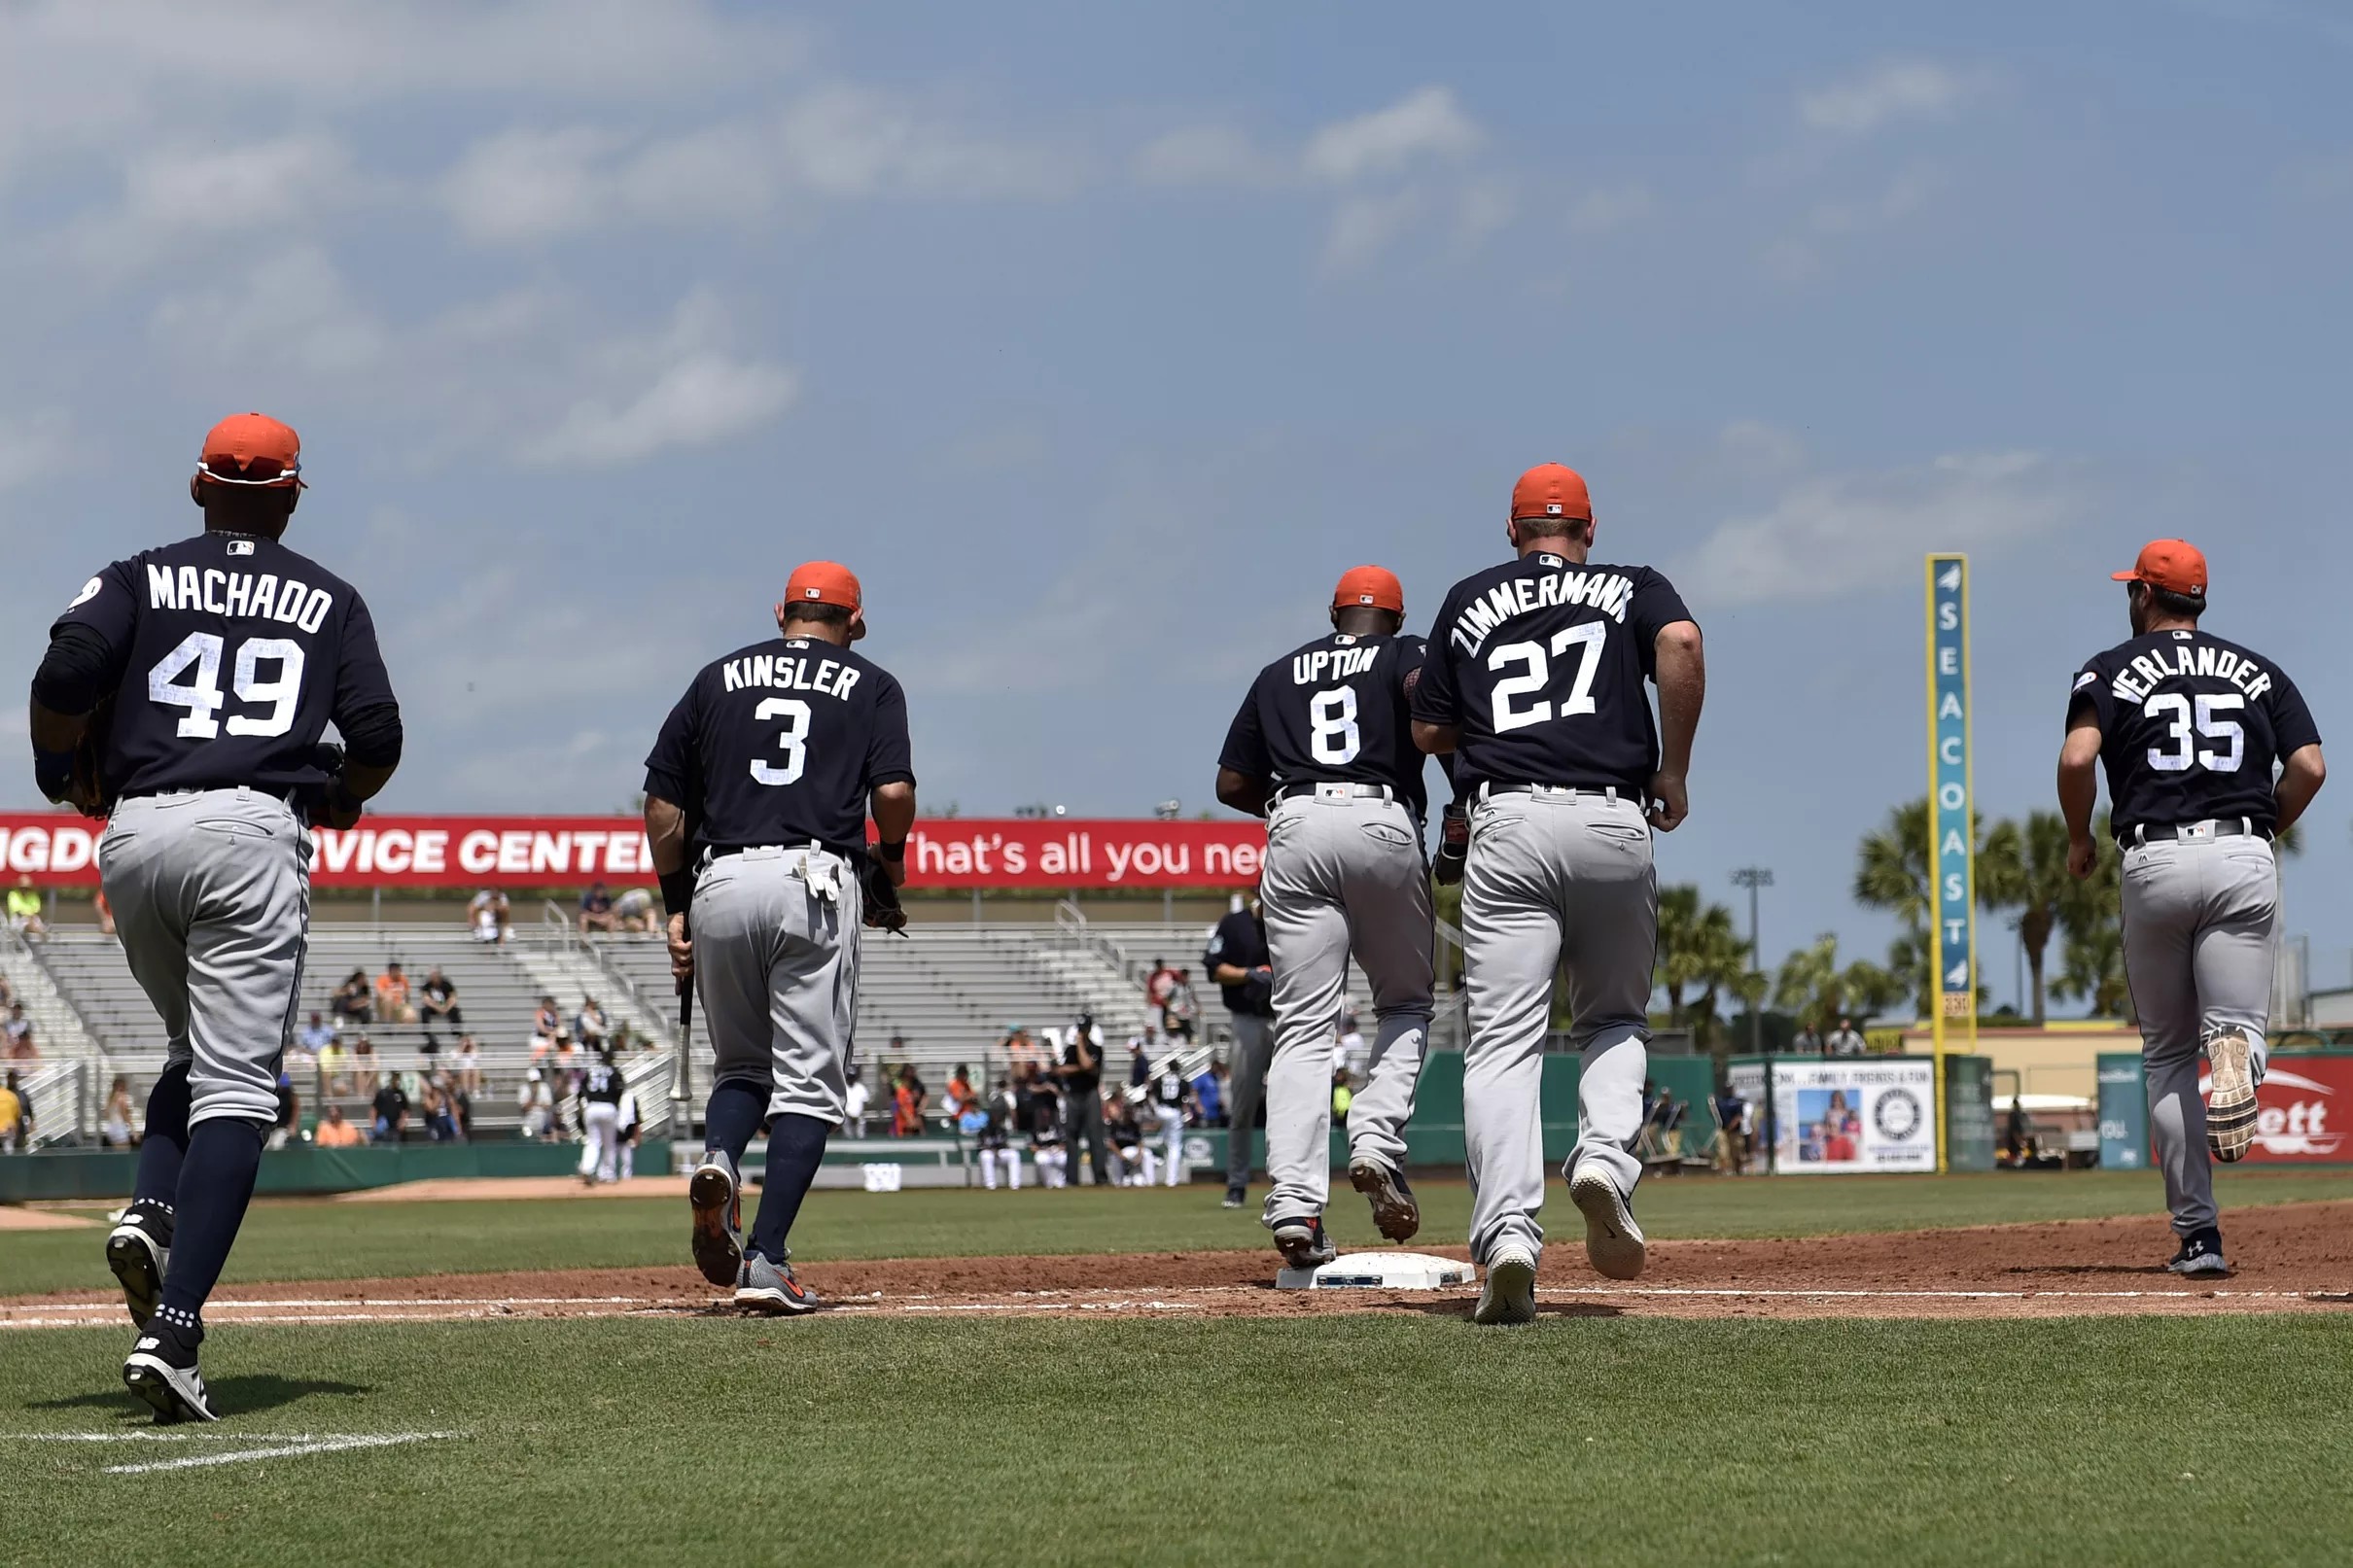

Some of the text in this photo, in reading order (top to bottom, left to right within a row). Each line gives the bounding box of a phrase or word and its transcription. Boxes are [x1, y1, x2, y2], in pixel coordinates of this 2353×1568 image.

[147, 563, 333, 634] MACHADO
[1450, 571, 1634, 659] ZIMMERMANN
[148, 631, 305, 739] 49
[722, 654, 860, 702] KINSLER
[1293, 645, 1381, 685] UPTON
[1487, 620, 1607, 734] 27
[2112, 645, 2272, 704] VERLANDER
[750, 697, 812, 786] 3
[1310, 684, 1361, 765] 8
[2143, 692, 2245, 772] 35
[1938, 601, 1966, 946] SEACOAST
[906, 831, 1266, 883] hat's all you ne
[2257, 1099, 2328, 1135] ett
